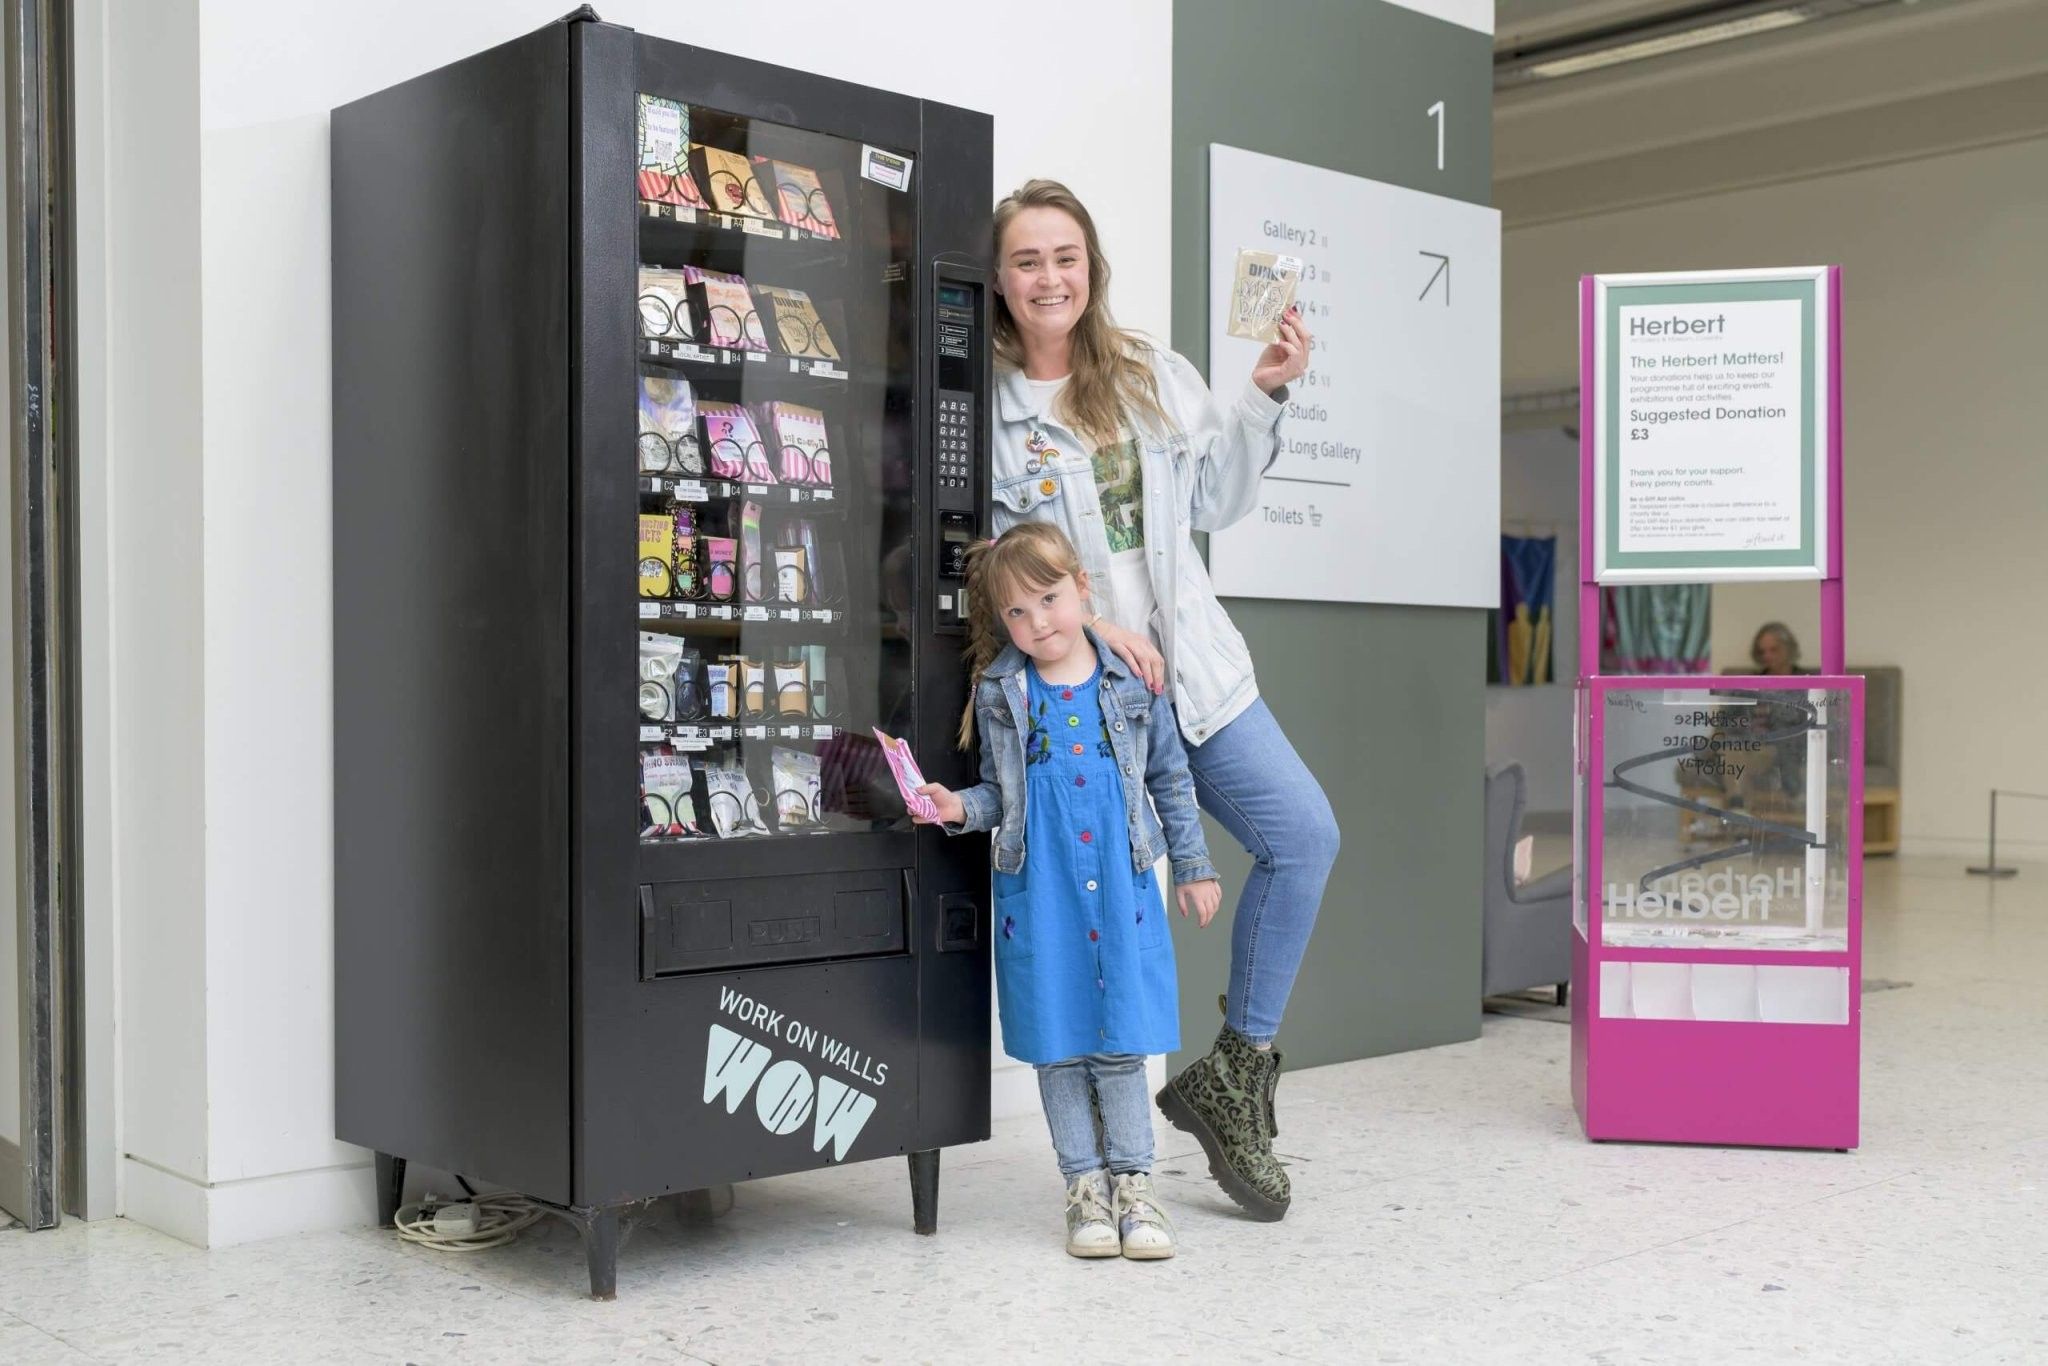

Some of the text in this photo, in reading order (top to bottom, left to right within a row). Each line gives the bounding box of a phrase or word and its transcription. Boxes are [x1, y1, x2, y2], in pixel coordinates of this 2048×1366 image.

[1427, 100, 1444, 170] 1
[660, 205, 671, 215] A2
[733, 219, 743, 228] A4
[1264, 220, 1306, 246] Gallery
[1309, 230, 1316, 245] 2
[1310, 265, 1316, 280] 3
[1309, 300, 1316, 314] 4
[1630, 315, 1726, 336] Herbert
[660, 344, 670, 354] B2
[731, 353, 741, 363] B4
[1631, 352, 1784, 368] The Herbert Matters!
[1309, 371, 1316, 385] 6
[1630, 374, 1648, 383] Your
[1650, 372, 1692, 382] donations
[1694, 371, 1713, 382] help
[1726, 371, 1735, 380] to
[1736, 371, 1759, 381] keep
[1761, 371, 1775, 379] our
[1630, 384, 1680, 395] programme
[1682, 383, 1695, 392] full
[1696, 383, 1705, 392] of
[1707, 382, 1740, 393] exciting
[1630, 394, 1674, 403] exhibitions
[1676, 393, 1693, 402] and
[1289, 403, 1328, 422] Studio
[1630, 406, 1786, 425] Suggested Donation
[1631, 428, 1649, 440] £3
[1289, 439, 1318, 460] Long
[1320, 442, 1362, 464] Gallery
[1630, 467, 1744, 478] Thank you for your support.
[663, 480, 674, 491] C2
[1630, 478, 1714, 489] Every penny counts.
[731, 486, 741, 496] C4
[1263, 506, 1304, 525] Toilets
[661, 606, 672, 616] D2
[697, 606, 707, 616] D3
[733, 607, 742, 617] D4
[768, 609, 776, 618] D5
[802, 610, 811, 620] D6
[833, 611, 842, 620] D7
[1693, 711, 1749, 728] Please
[698, 728, 708, 738] E3
[733, 728, 743, 738] E4
[768, 727, 776, 737] E5
[801, 727, 811, 737] E6
[833, 727, 843, 736] E7
[1693, 735, 1761, 751] Donate
[1694, 758, 1745, 780] Today
[1607, 882, 1773, 921] Herbert
[719, 985, 889, 1086] WORK ON WALLS
[703, 1023, 877, 1162] WOW
